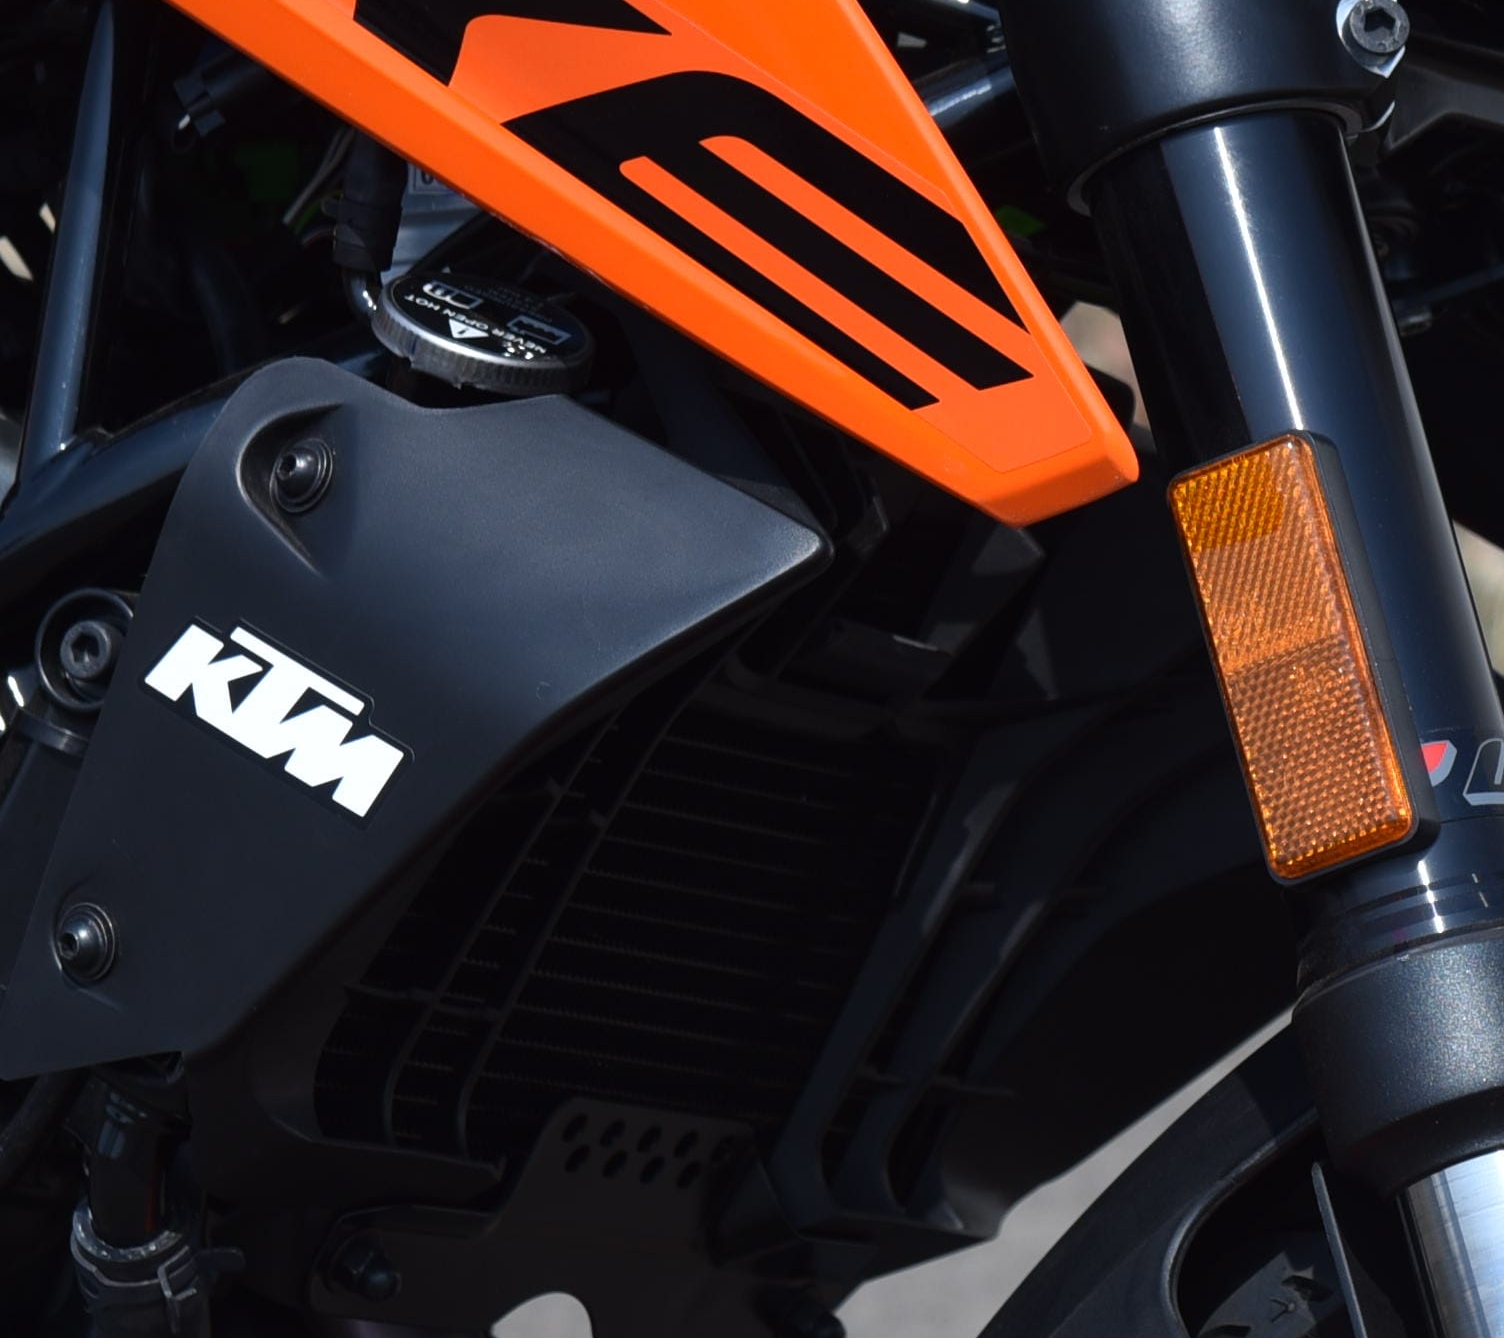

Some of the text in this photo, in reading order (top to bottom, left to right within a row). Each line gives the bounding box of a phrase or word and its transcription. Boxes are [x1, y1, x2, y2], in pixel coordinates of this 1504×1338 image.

[403, 293, 442, 311] HOT
[442, 308, 490, 331] OPEN
[491, 327, 547, 355] NEVER
[143, 621, 407, 819] KTM
